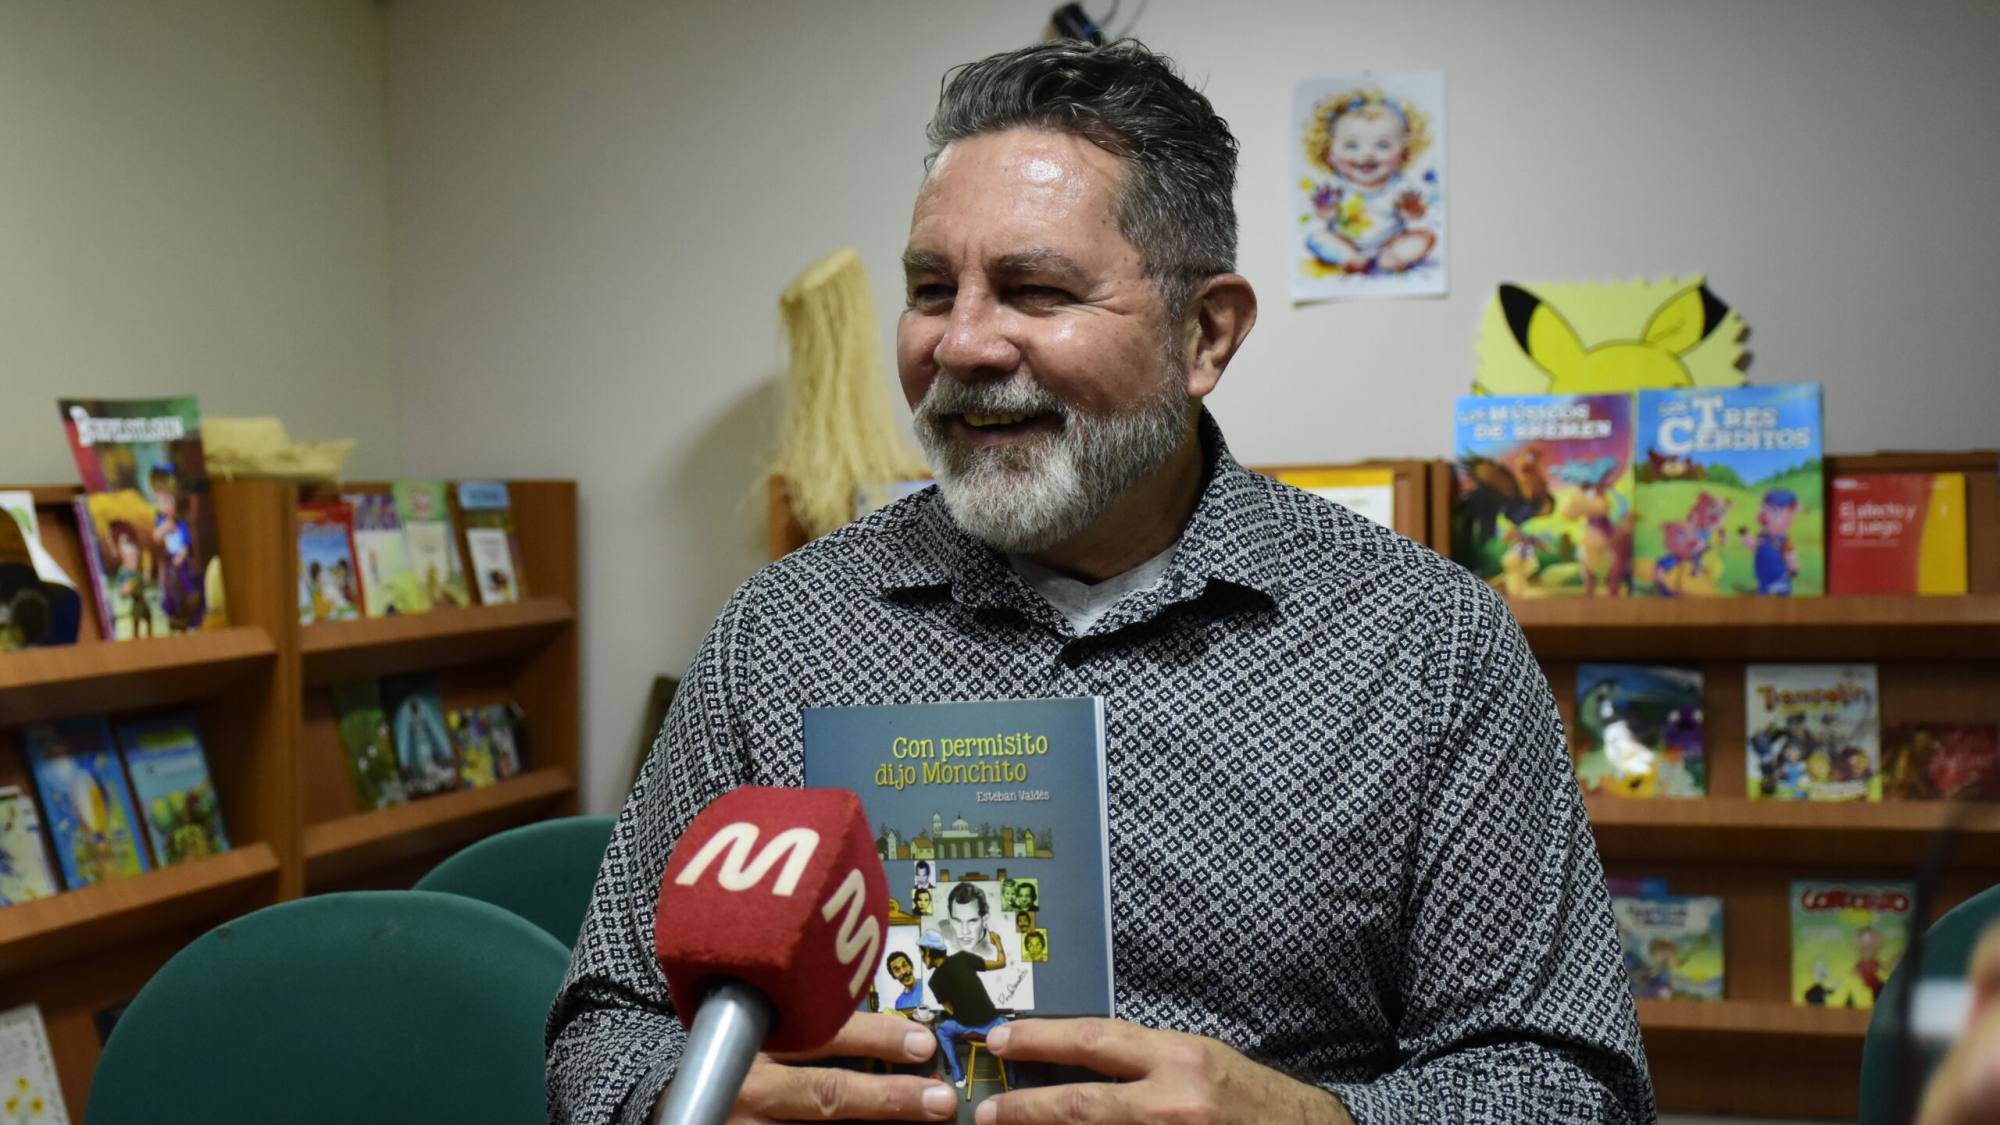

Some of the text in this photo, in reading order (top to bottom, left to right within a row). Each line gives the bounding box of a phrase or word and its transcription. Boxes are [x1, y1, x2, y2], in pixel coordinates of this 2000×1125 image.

[1840, 501, 1855, 518] El
[1857, 501, 1904, 519] afecto
[1840, 519, 1855, 534] el
[893, 733, 1048, 762] Con permisito
[875, 761, 1027, 790] dijo Monchito
[976, 791, 1017, 802] Esteban
